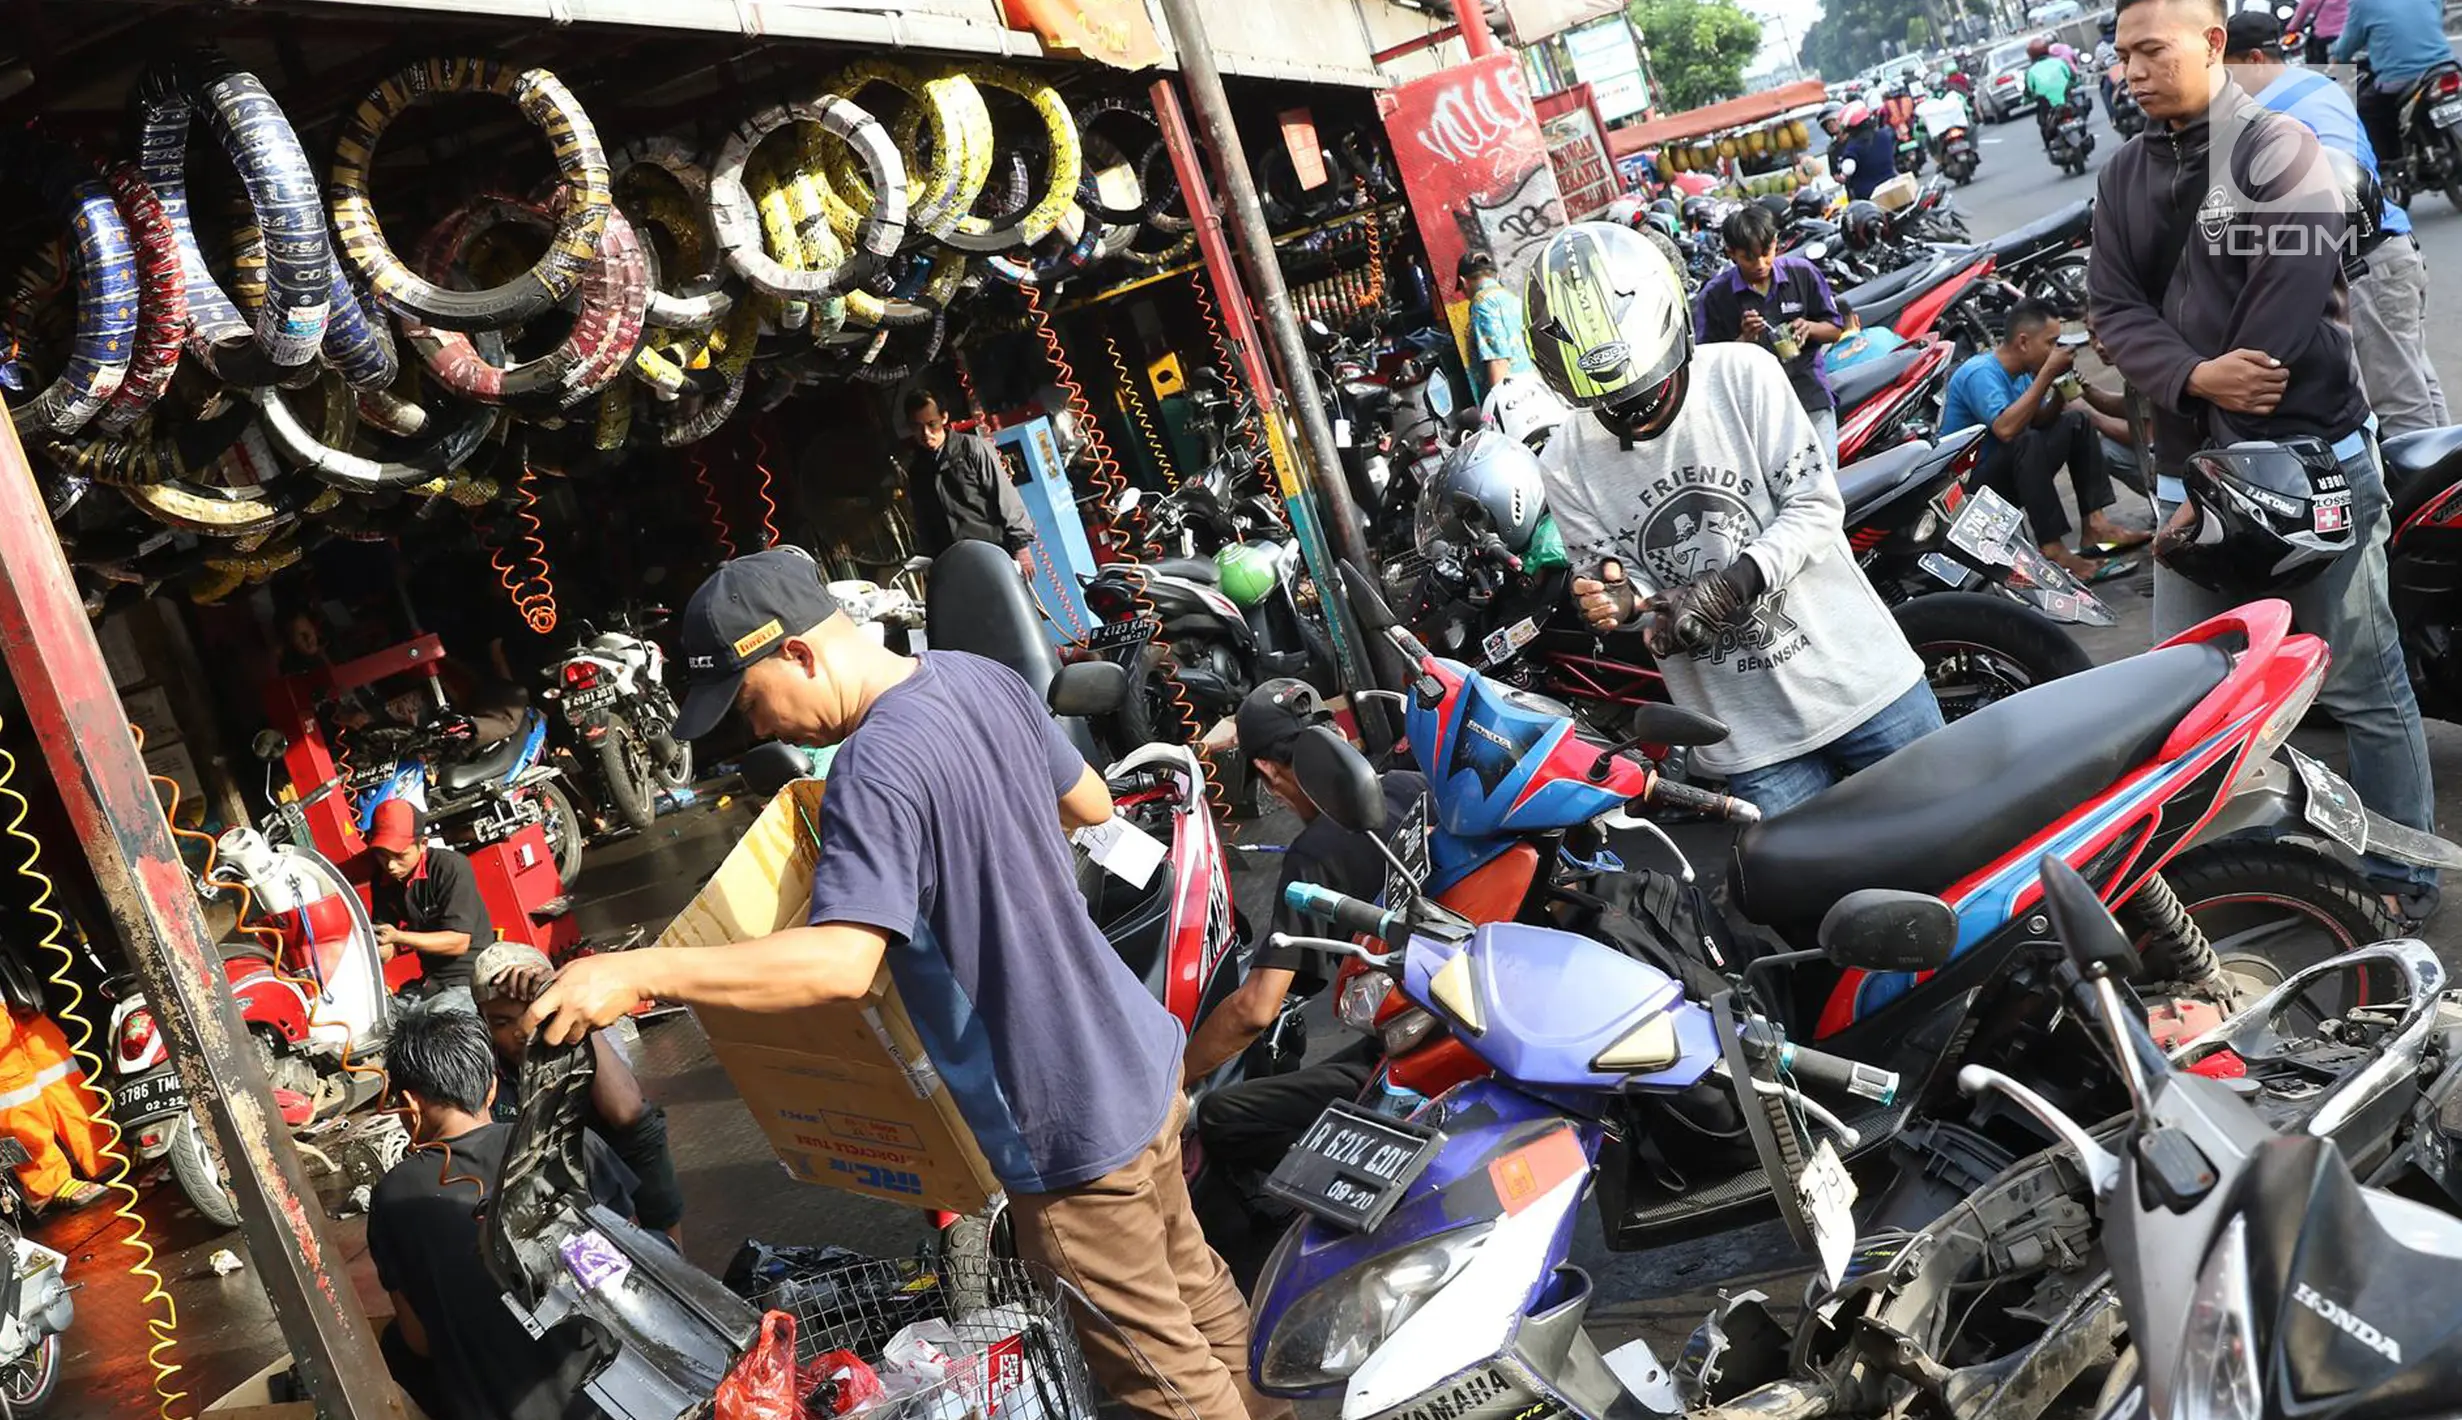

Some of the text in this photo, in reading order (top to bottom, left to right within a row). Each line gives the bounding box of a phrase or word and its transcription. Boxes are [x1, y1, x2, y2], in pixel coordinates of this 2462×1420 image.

[1466, 719, 1512, 750] HONDA
[119, 1083, 149, 1106] 3786
[2292, 1281, 2402, 1364] HONDA
